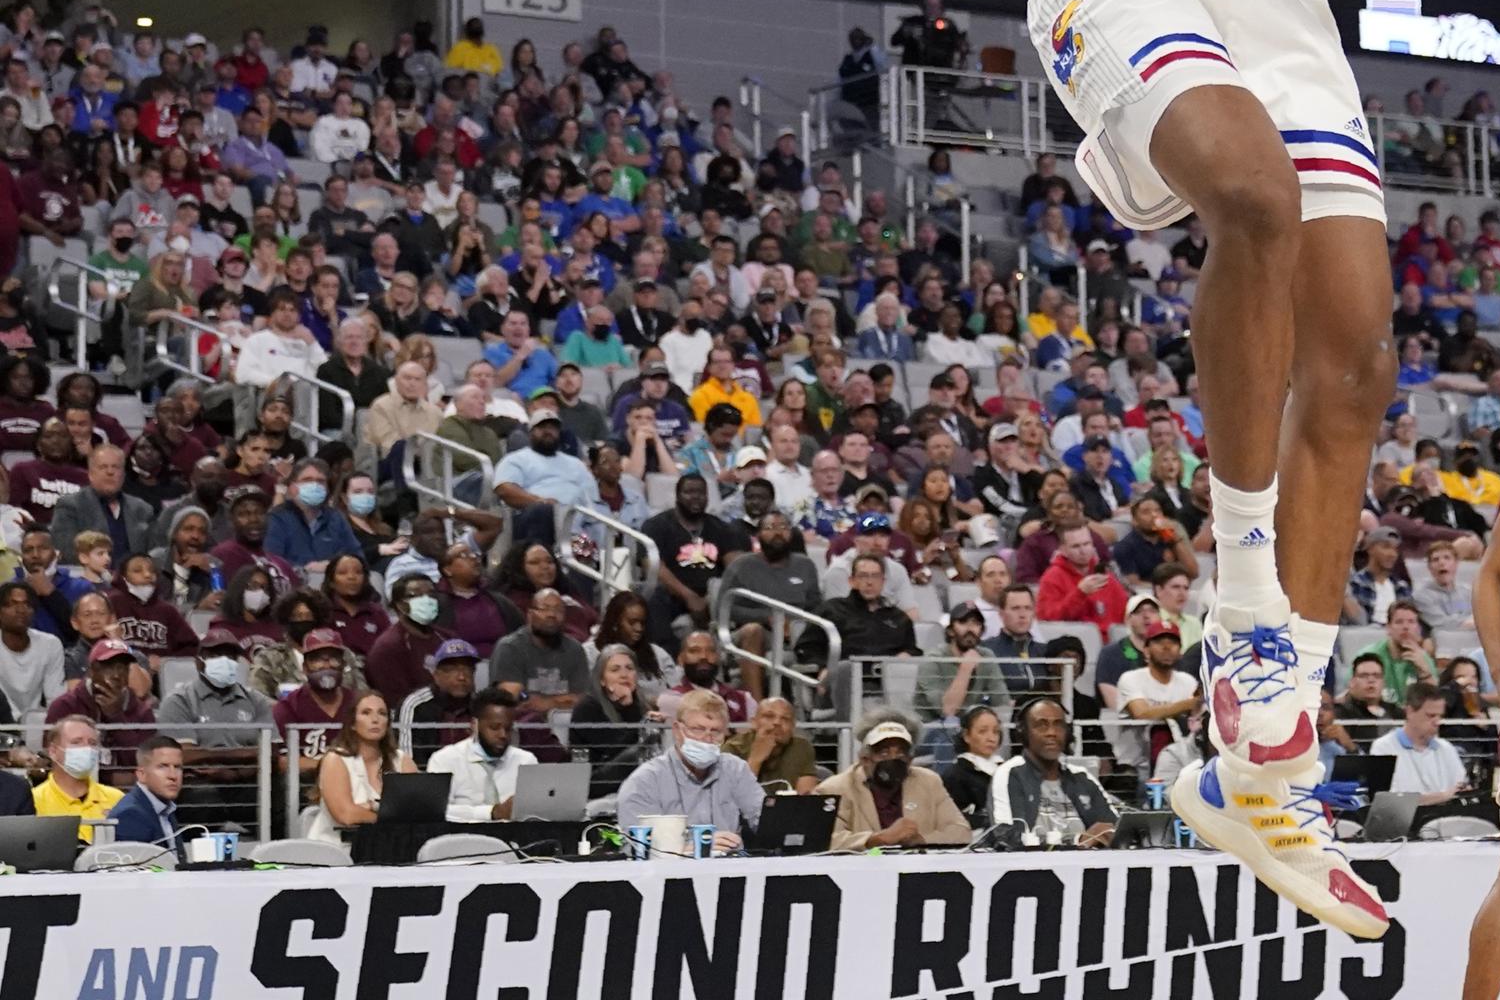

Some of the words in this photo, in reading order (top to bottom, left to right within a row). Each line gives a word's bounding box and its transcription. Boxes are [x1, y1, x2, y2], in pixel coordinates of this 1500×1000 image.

[76, 945, 220, 1000] AND
[251, 875, 841, 1000] SECOND
[891, 860, 1406, 1000] ROUNDS
